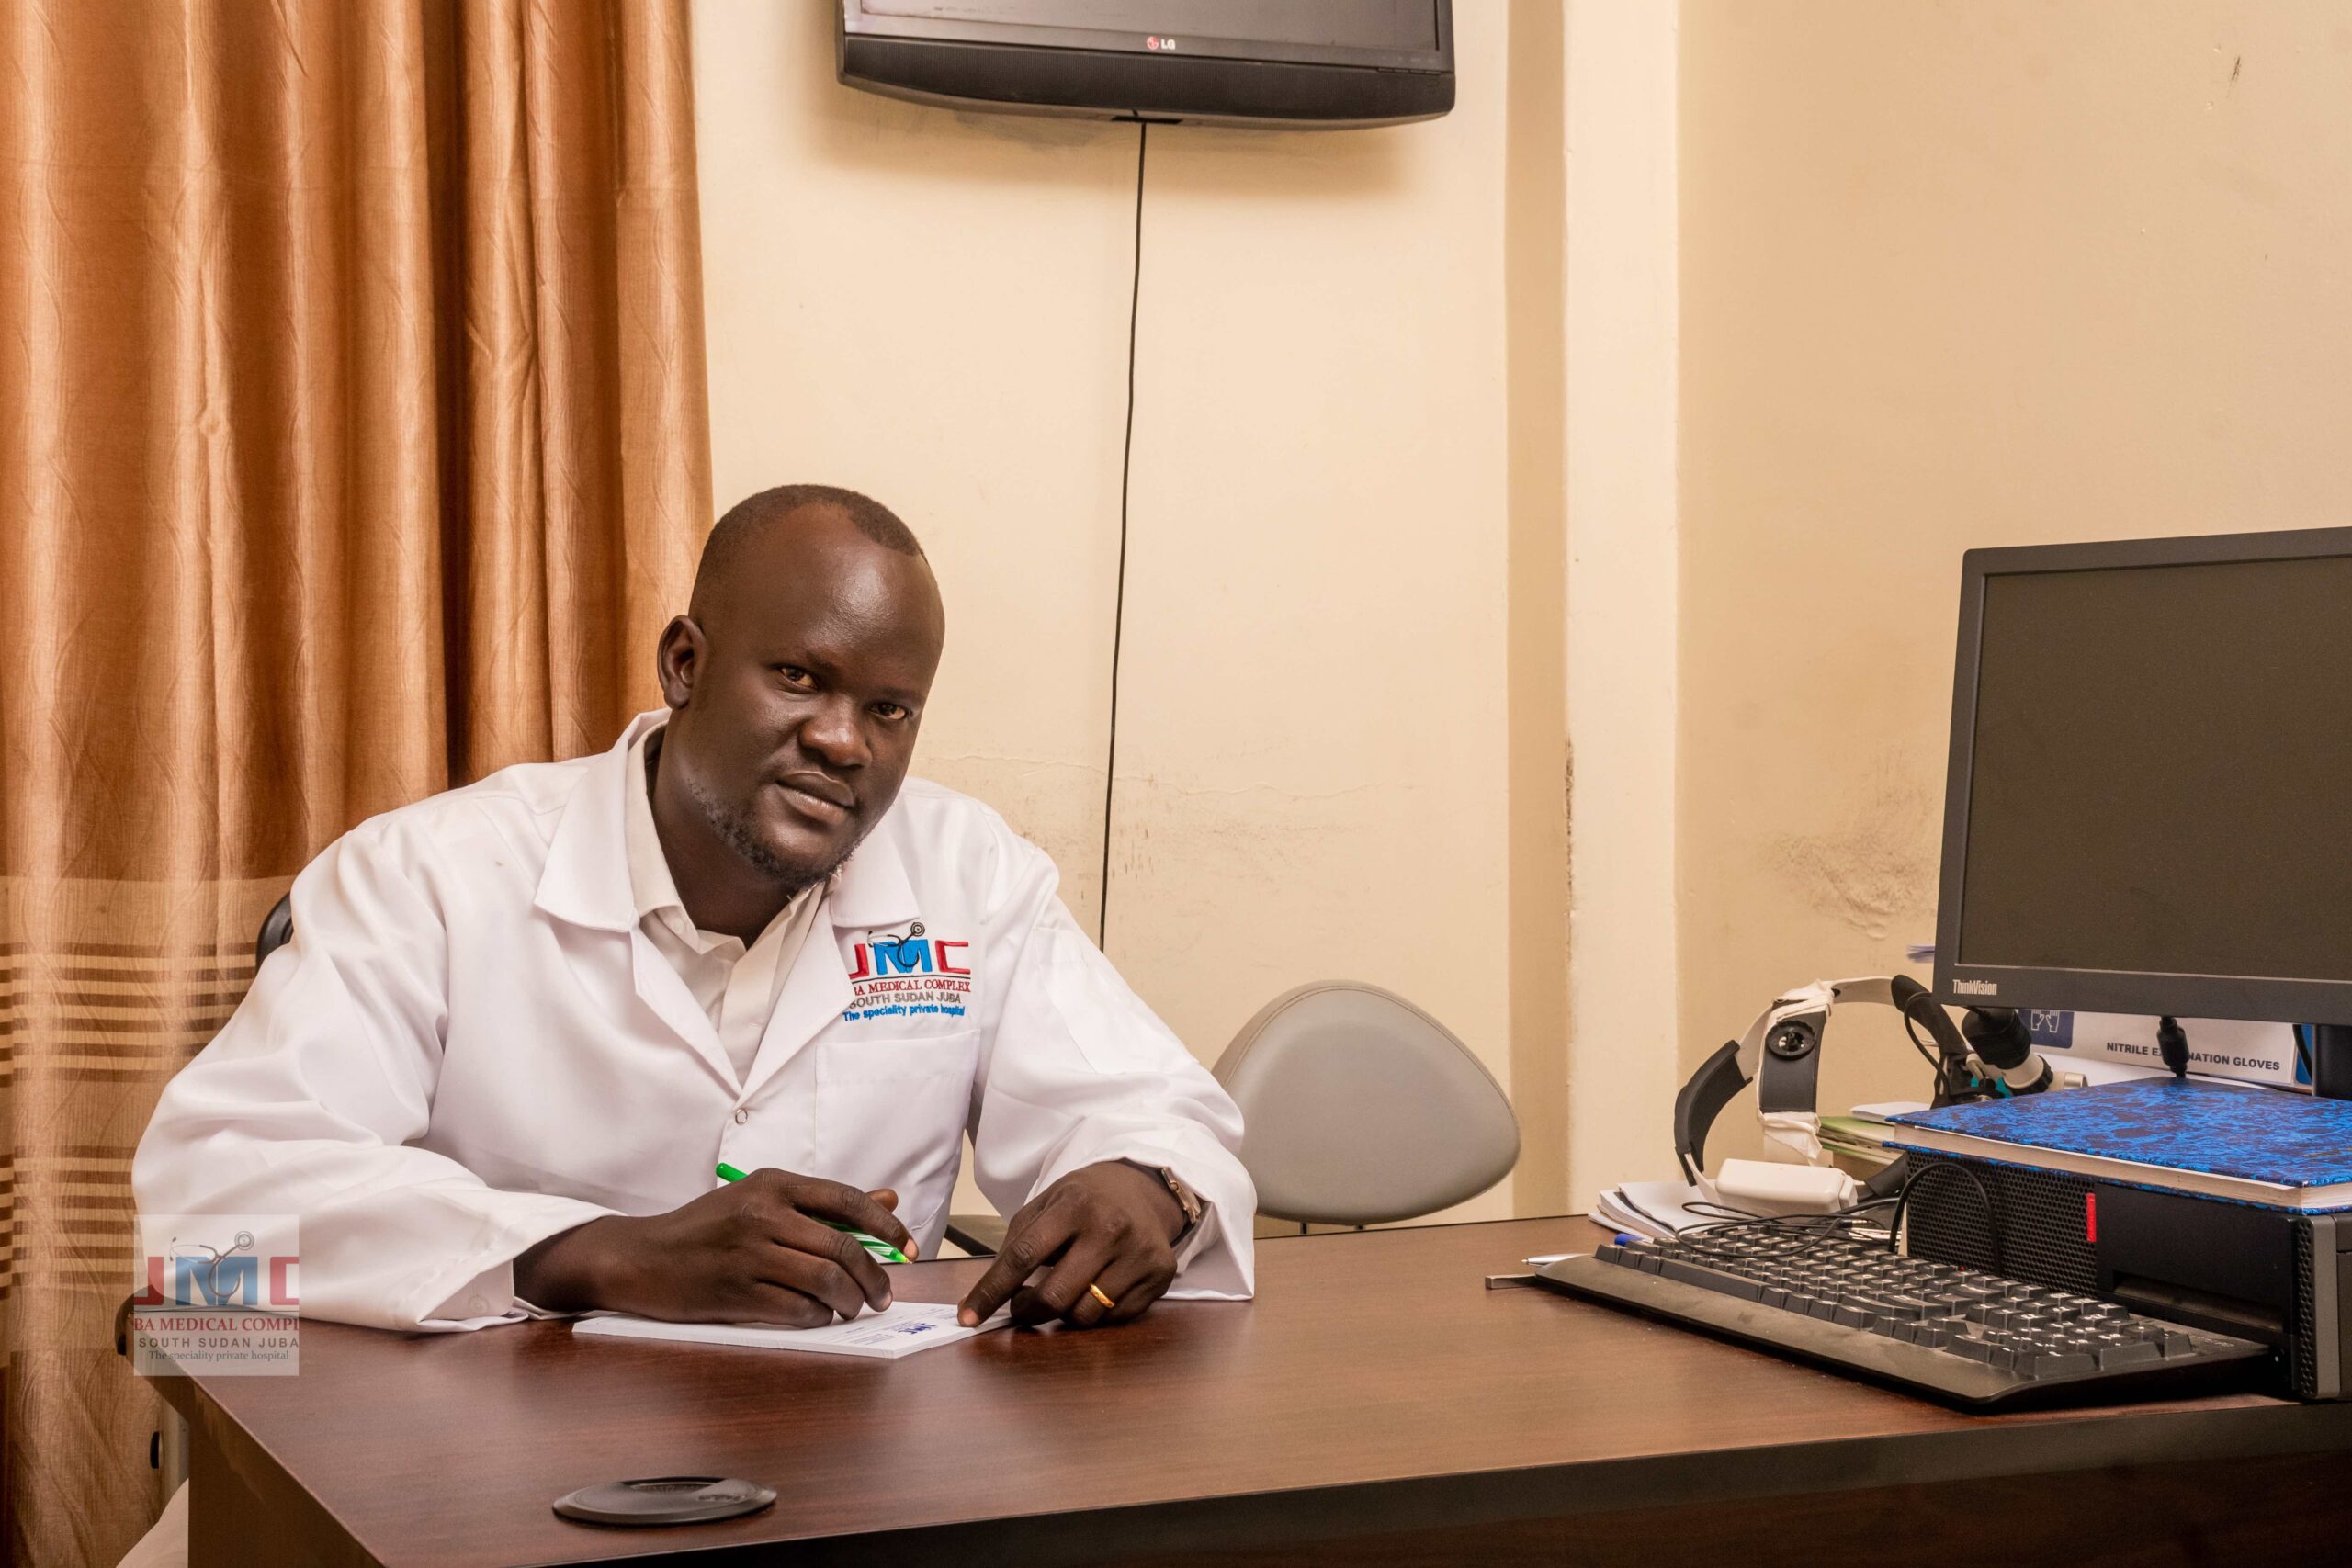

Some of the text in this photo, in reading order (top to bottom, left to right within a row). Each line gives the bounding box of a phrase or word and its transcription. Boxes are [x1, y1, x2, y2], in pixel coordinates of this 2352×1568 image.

[1160, 39, 1176, 50] LG
[849, 939, 971, 979] JMC
[868, 980, 922, 994] MEDICAL
[924, 979, 970, 992] COMPLEX
[1952, 979, 1997, 996] ThinkVision
[894, 991, 934, 1003] SUDAN
[936, 992, 961, 1004] JUBA
[843, 1003, 965, 1021] The speciality private hospital
[2107, 1043, 2280, 1071] NITRILE ENATION GLOVES
